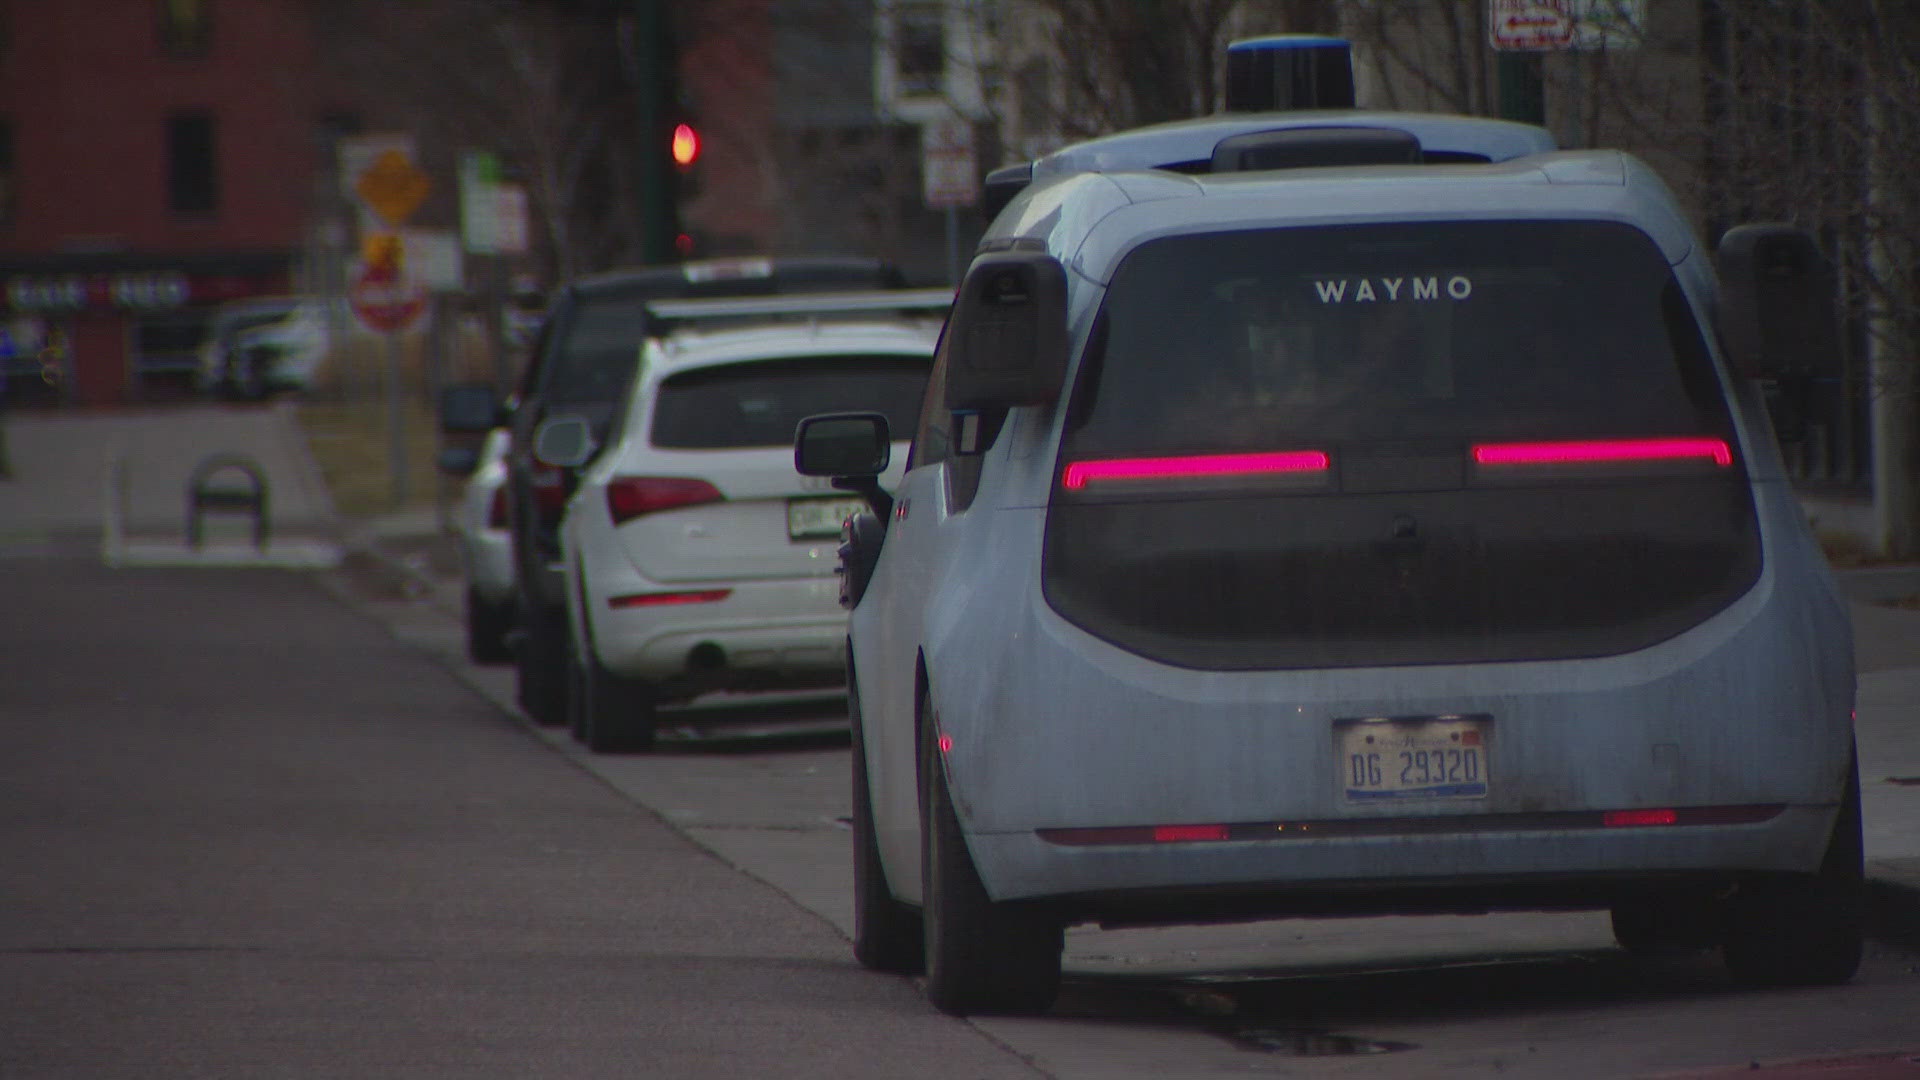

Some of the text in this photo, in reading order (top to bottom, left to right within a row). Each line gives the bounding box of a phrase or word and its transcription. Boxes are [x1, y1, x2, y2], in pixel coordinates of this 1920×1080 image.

[1315, 276, 1472, 303] WAYMO
[1351, 749, 1478, 786] DG 29320
